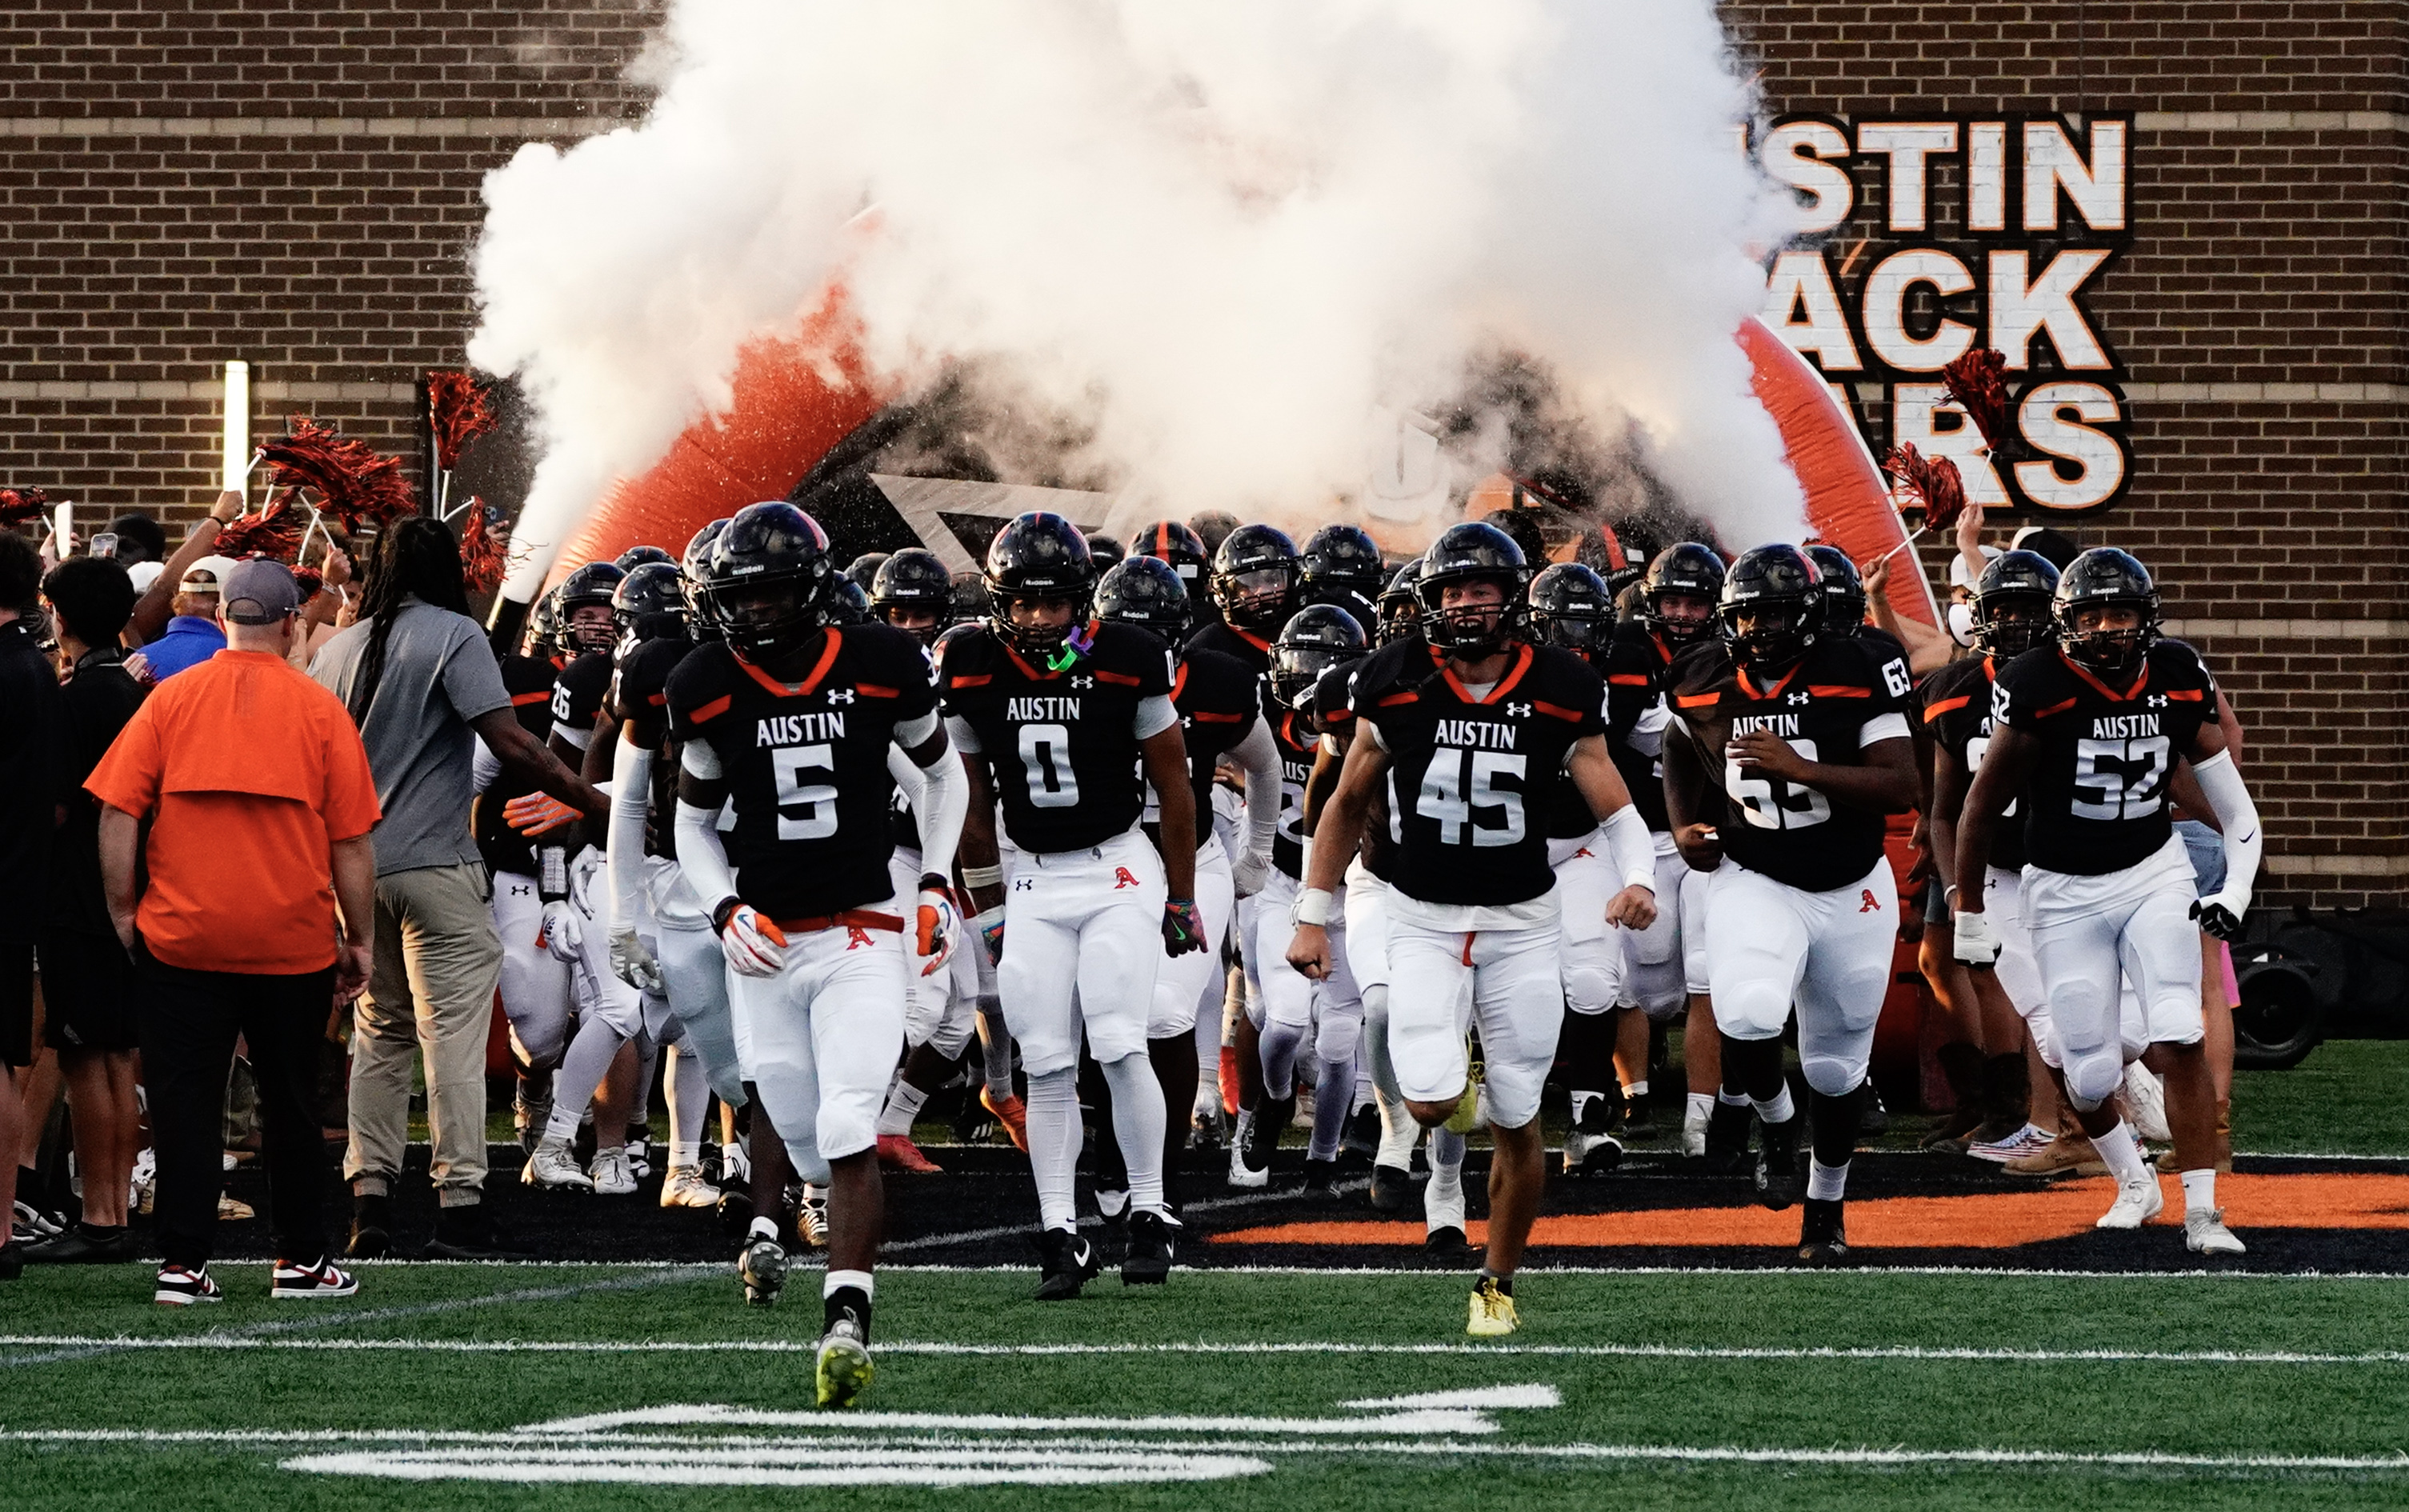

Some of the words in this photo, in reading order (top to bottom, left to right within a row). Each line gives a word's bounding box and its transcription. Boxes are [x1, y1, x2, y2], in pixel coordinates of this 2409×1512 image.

[1738, 121, 2127, 233] STIN
[1763, 248, 2114, 372] ACK
[1122, 610, 1150, 619] Riddell
[1006, 697, 1080, 721] AUSTIN
[1991, 679, 2011, 725] 52
[756, 711, 846, 748] AUSTIN
[1434, 718, 1517, 750] AUSTIN
[1732, 713, 1799, 741] AUSTIN
[2093, 713, 2159, 740] AUSTIN
[1018, 723, 1080, 808] 0
[1725, 738, 1831, 830] 63
[2071, 734, 2171, 821] 52
[771, 742, 838, 841] 5
[1416, 746, 1527, 847] 45
[1114, 866, 1140, 890] A
[1859, 888, 1882, 913] A
